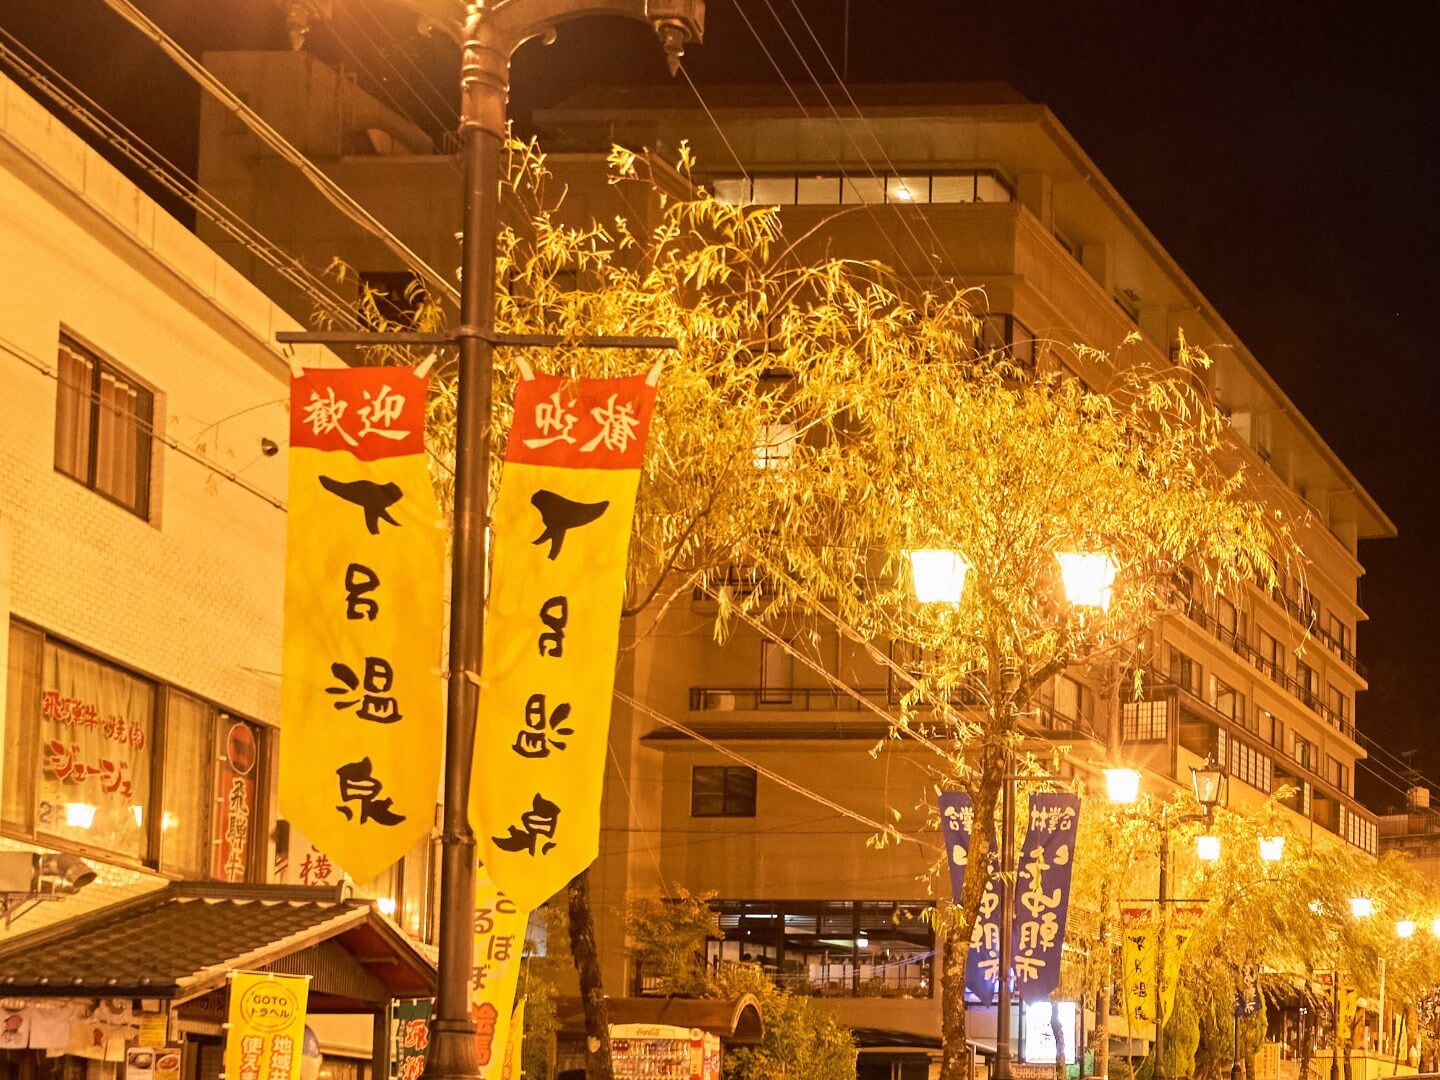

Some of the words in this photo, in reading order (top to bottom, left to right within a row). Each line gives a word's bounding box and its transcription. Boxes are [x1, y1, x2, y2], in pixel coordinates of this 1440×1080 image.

[303, 384, 411, 446] 歓迎
[319, 476, 405, 826] 下呂温泉
[250, 1006, 290, 1019] トラベル
[253, 995, 288, 1006] GOTO
